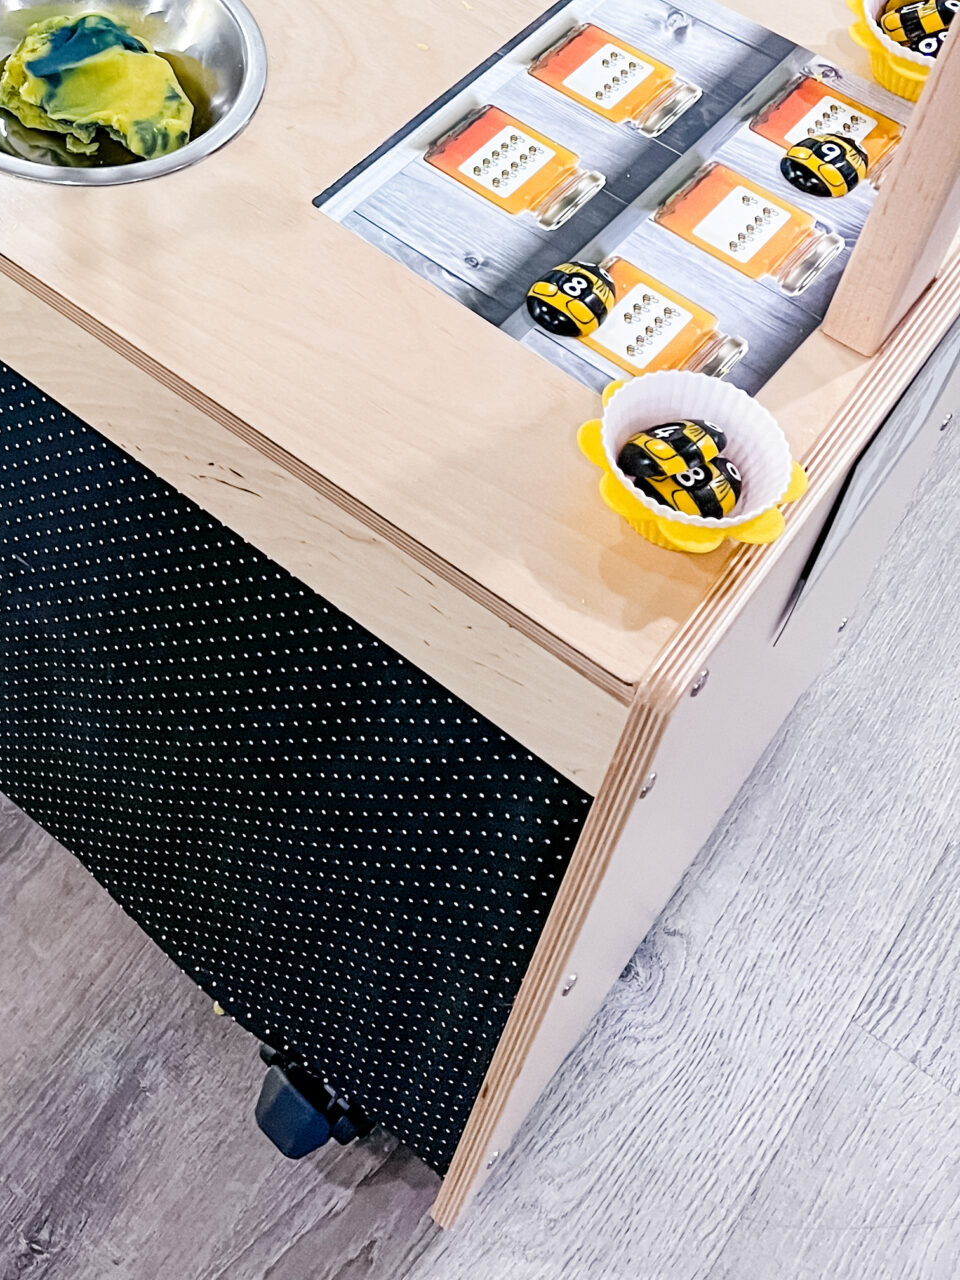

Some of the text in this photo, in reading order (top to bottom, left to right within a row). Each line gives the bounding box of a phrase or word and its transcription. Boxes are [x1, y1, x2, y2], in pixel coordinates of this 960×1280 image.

[821, 143, 842, 162] 9
[562, 276, 588, 297] 8
[654, 425, 681, 439] 4
[675, 467, 706, 487] 8
